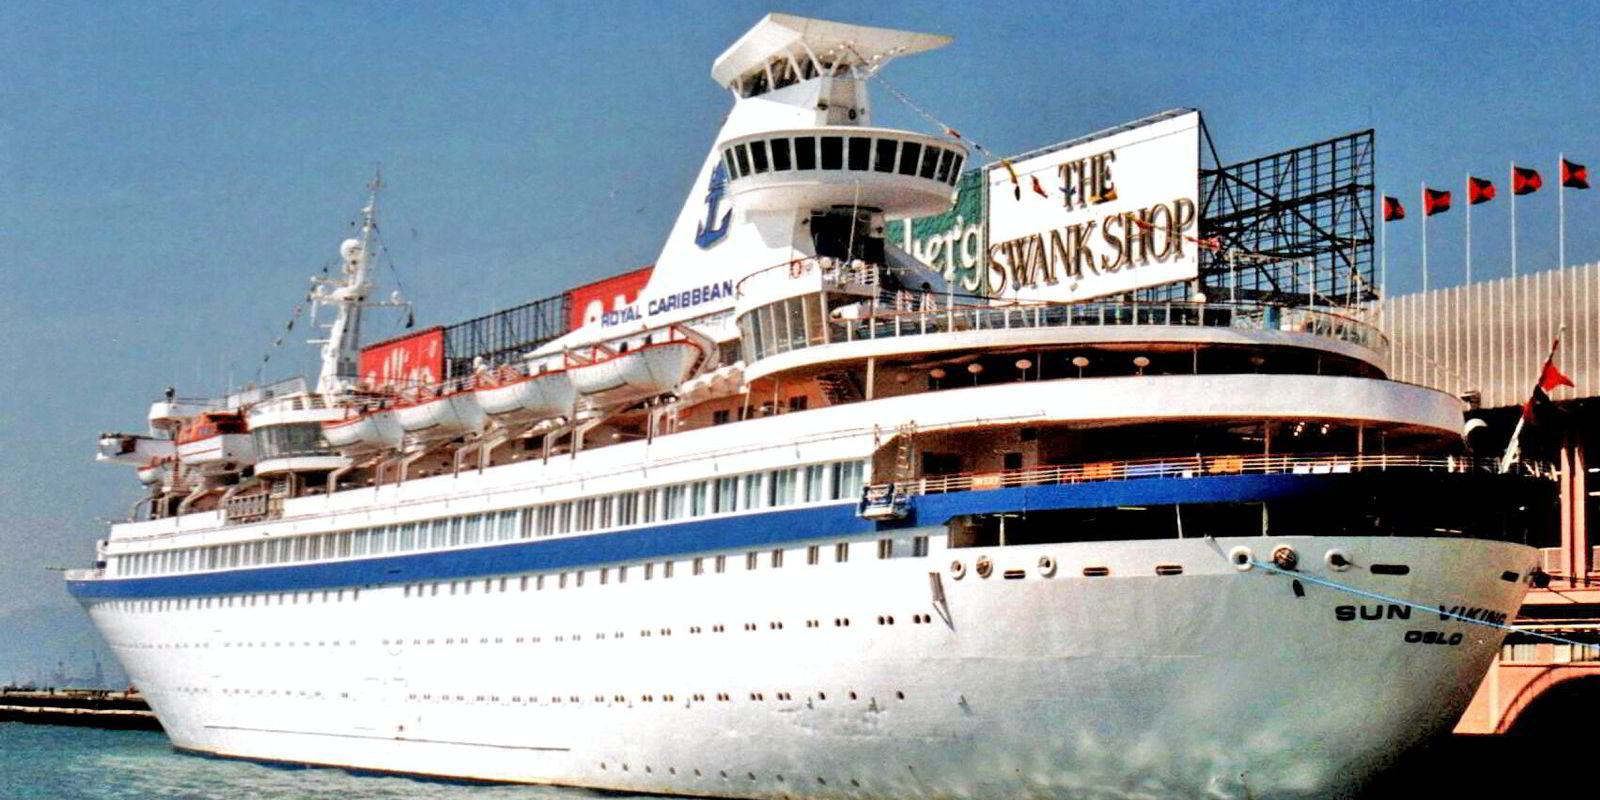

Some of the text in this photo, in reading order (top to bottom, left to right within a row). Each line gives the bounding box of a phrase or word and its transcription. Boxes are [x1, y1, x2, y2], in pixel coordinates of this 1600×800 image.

[1057, 150, 1117, 212] THE
[987, 197, 1196, 296] SWANK SHOP
[601, 304, 643, 328] ROYAL
[648, 279, 734, 317] CARIBBEAN
[1334, 604, 1412, 622] SUN
[1404, 630, 1463, 646] OSLO
